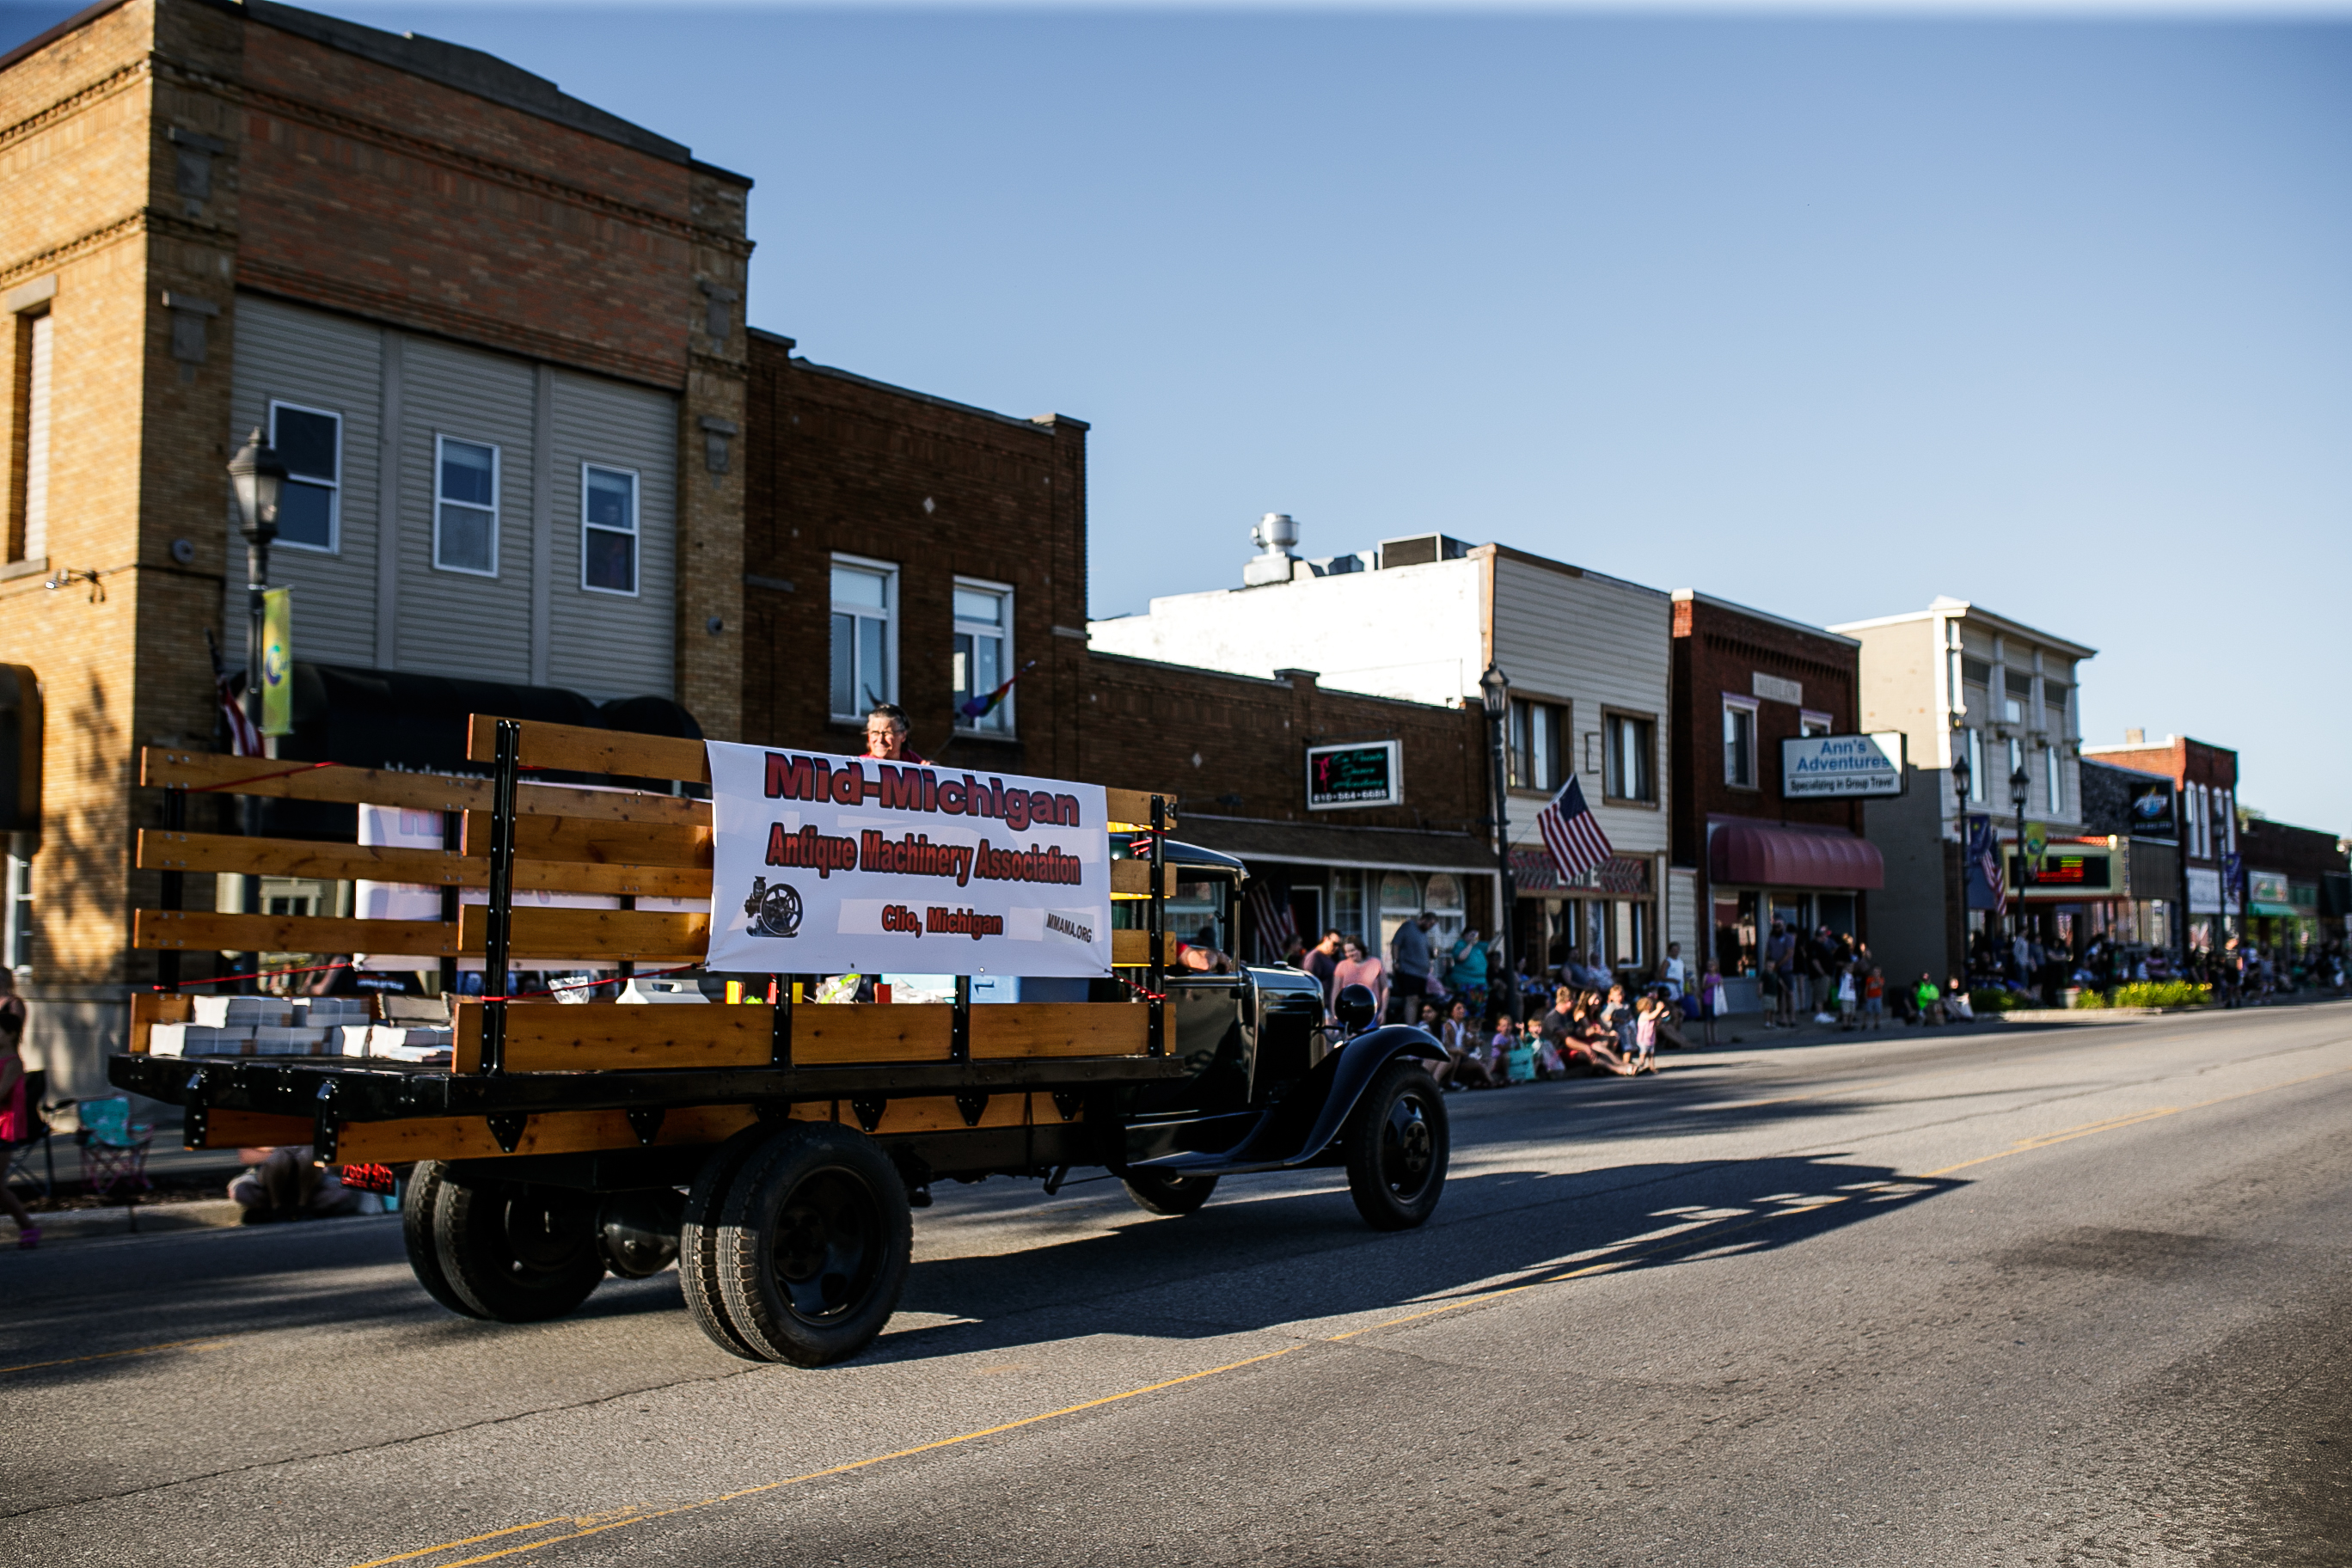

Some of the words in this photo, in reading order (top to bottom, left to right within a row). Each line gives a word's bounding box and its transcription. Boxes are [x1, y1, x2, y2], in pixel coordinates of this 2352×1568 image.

[1821, 739, 1867, 755] Ann's
[1797, 756, 1891, 772] Adventures
[764, 751, 1080, 831] Mid-Michigan
[1791, 777, 1834, 792] Specializing
[1836, 781, 1844, 789] in
[1846, 778, 1869, 791] Group
[1871, 775, 1895, 787] Travel
[765, 823, 858, 879] Antique
[860, 830, 973, 886] Machinery
[974, 839, 1081, 885] Association
[881, 904, 922, 937] Clio,
[927, 908, 1003, 940] Michigan
[1046, 913, 1093, 943] MMAMA.ORG
